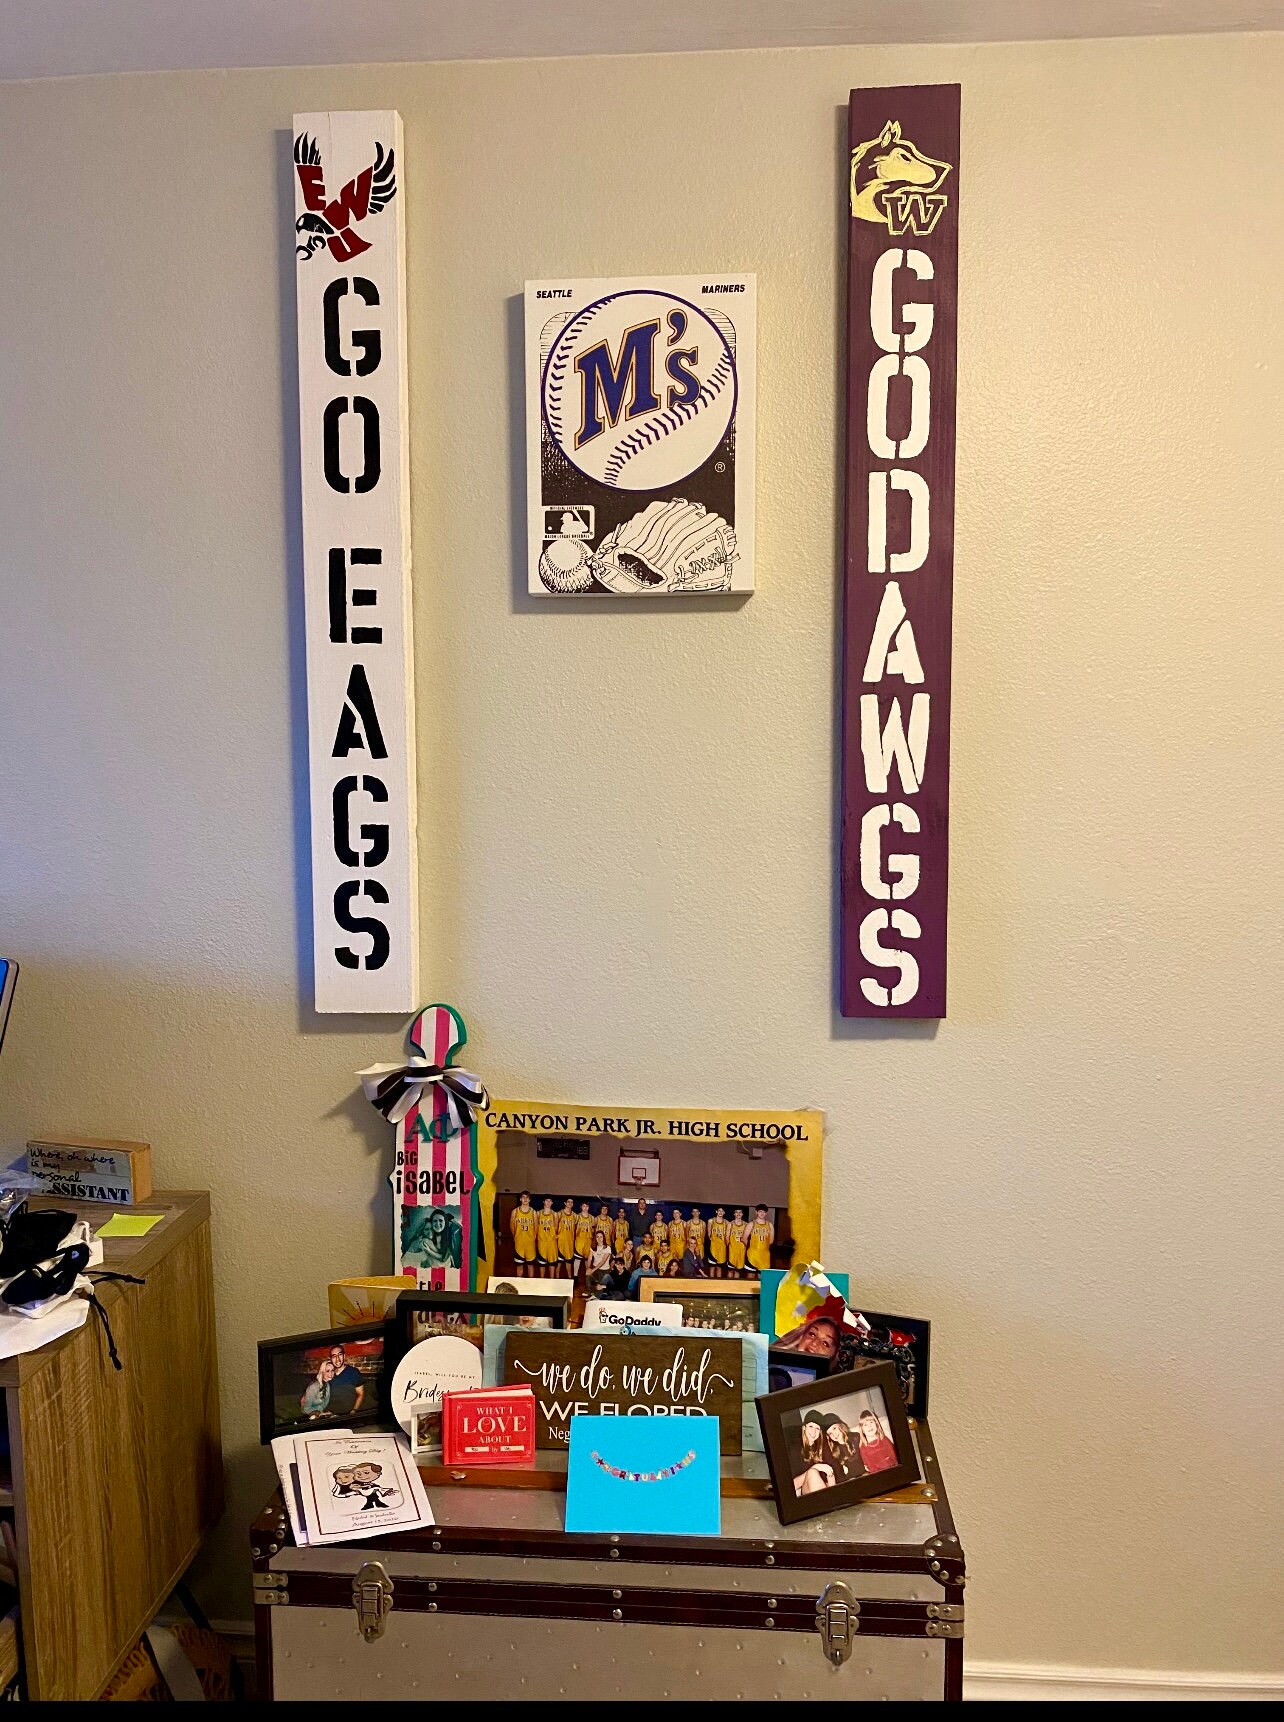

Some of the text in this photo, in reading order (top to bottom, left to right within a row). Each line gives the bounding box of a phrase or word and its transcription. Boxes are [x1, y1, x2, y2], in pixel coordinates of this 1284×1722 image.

[535, 289, 573, 299] SEATTLE
[701, 284, 746, 294] MARINERS
[322, 276, 390, 971] GO EAGS
[859, 468, 931, 1007] DAWGS
[485, 1112, 809, 1141] CANYON PARK JR. HIGH SCHOOL
[31, 1158, 39, 1168] is
[84, 1153, 116, 1165] where
[43, 1183, 129, 1201] SSISTANT
[514, 1359, 577, 1394] we
[622, 1365, 659, 1397] we
[476, 1406, 513, 1415] WHAT I
[539, 1400, 589, 1421] WE
[462, 1416, 527, 1434] LOVE
[479, 1435, 511, 1444] ABOUT
